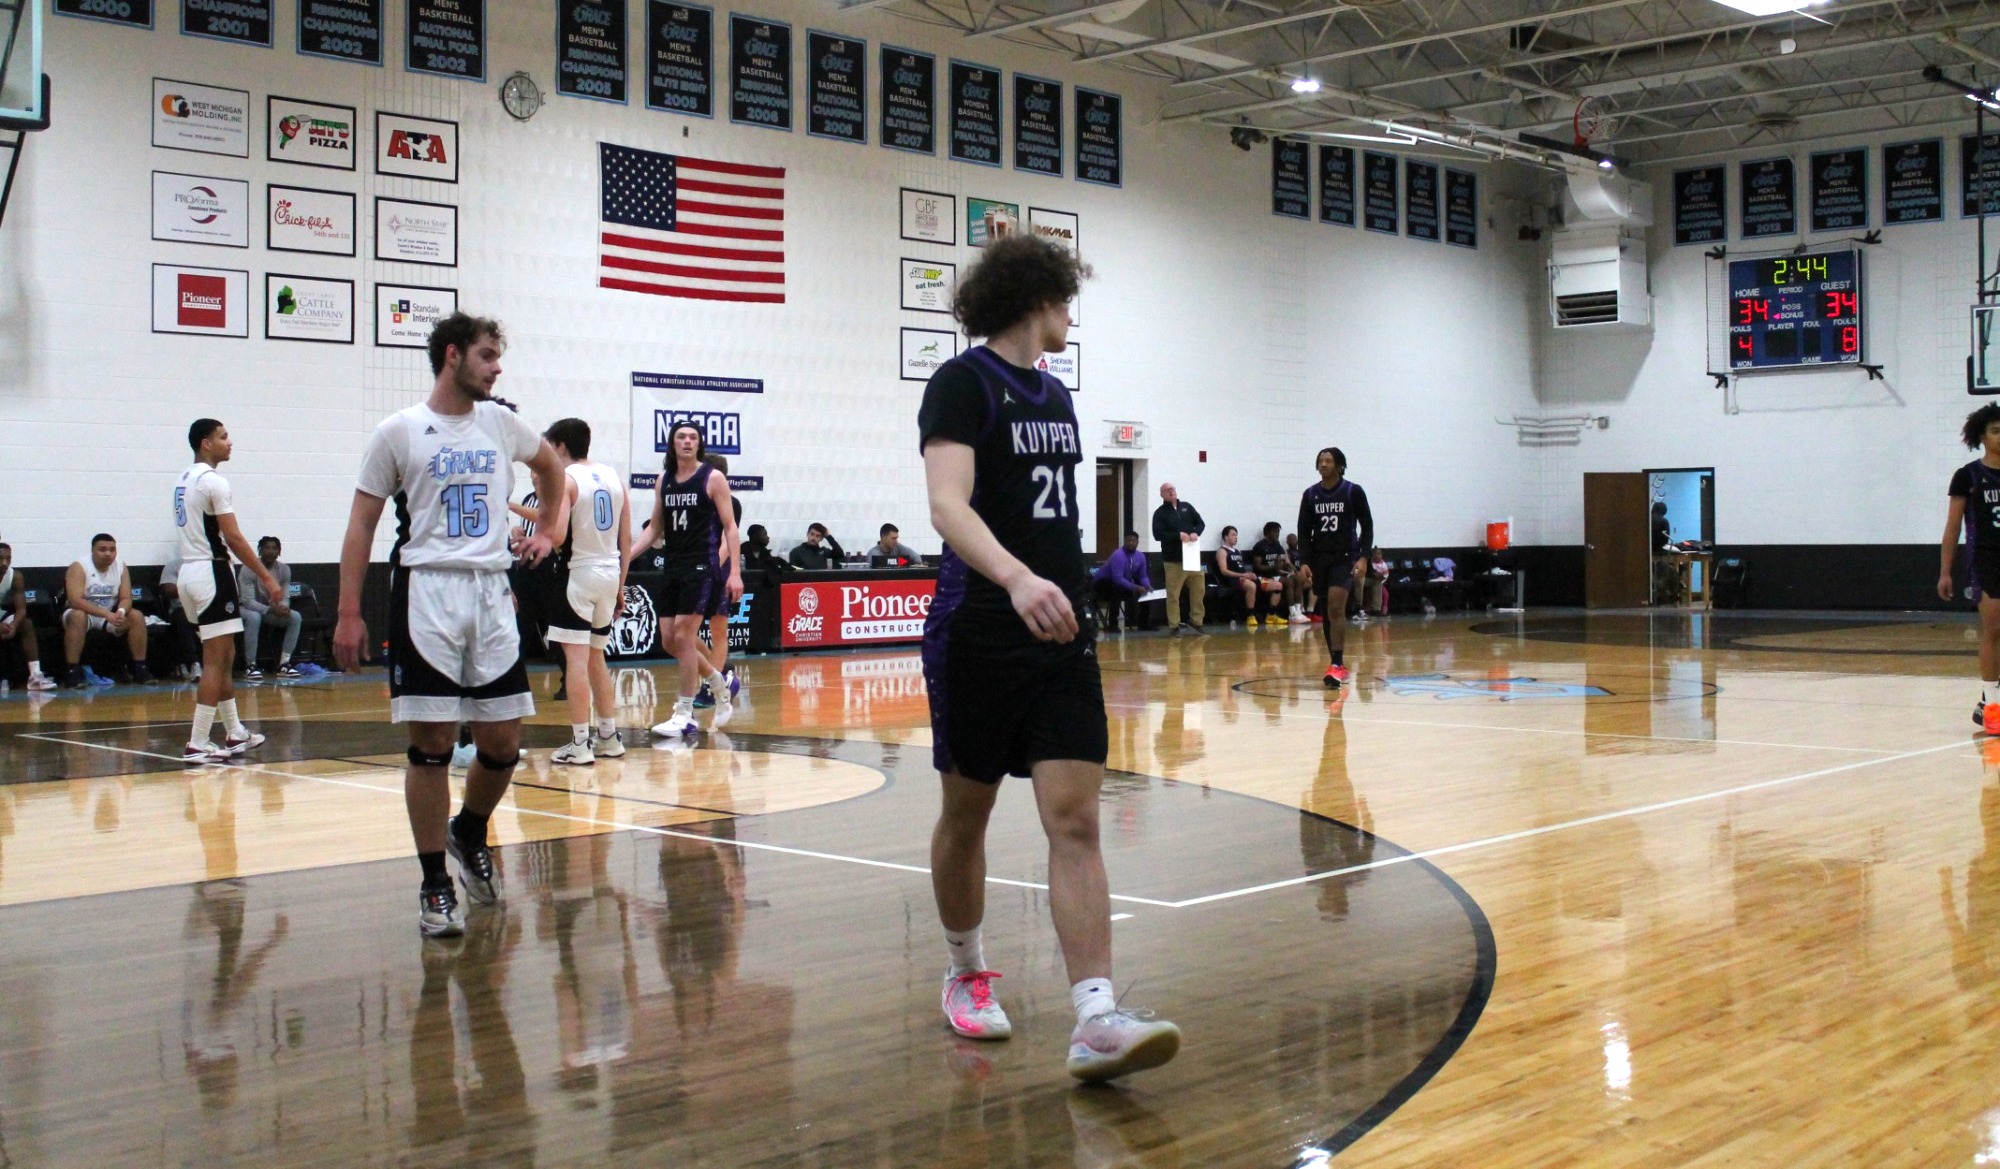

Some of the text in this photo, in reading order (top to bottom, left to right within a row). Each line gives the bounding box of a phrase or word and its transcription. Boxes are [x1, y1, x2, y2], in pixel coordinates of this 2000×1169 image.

[79, 0, 131, 17] 2000
[187, 0, 268, 20] CHAMPIONS
[433, 0, 459, 9] MEN'S
[419, 7, 474, 24] BASKETBALL
[573, 4, 612, 25] GRACE
[208, 16, 250, 36] 2001
[303, 17, 377, 40] CHAMPIONS
[418, 21, 475, 41] NATIONAL
[581, 25, 605, 37] MEN'S
[661, 20, 698, 42] GRACE
[321, 36, 363, 55] 2002
[413, 35, 479, 55] FINAL FOUR
[568, 34, 618, 50] BASKETBALL
[669, 42, 691, 52] MEN'S
[744, 38, 779, 58] GRACE
[427, 53, 467, 72] 2002
[657, 51, 703, 66] BASKETBALL
[752, 58, 773, 68] MEN'S
[561, 61, 624, 81] CHAMPIONS
[657, 63, 704, 81] NATIONAL
[741, 66, 783, 81] BASKETBALL
[828, 72, 848, 83] MEN'S
[817, 80, 857, 95] BASKETBALL
[899, 86, 918, 97] MEN'S
[192, 101, 243, 114] WEST MICHIGAN
[664, 92, 698, 109] 2005
[889, 94, 928, 109] BASKETBALL
[963, 100, 989, 111] WOMEN'S
[957, 108, 994, 121] BASKETBALL
[1030, 112, 1047, 121] MEN'S
[309, 118, 349, 139] JET'S
[1021, 120, 1056, 133] BASKETBALL
[1090, 124, 1107, 134] MEN'S
[310, 136, 348, 150] PIZZA
[1082, 132, 1115, 145] BASKETBALL
[387, 129, 447, 164] ATA
[1891, 178, 1933, 188] BASKETBALL
[275, 206, 332, 230] Chick-fil-A
[405, 216, 448, 228] NORTH STAR
[314, 230, 326, 238] 54th
[910, 267, 943, 280] SUBWAY
[1774, 257, 1826, 284] 2:44
[1735, 280, 1851, 298] HOME PERIOD GUEST
[182, 291, 222, 304] Pioneer
[299, 297, 336, 309] CATTLE
[297, 306, 345, 320] COMPANY
[412, 303, 440, 313] Standale
[1739, 292, 1857, 325] 34 34
[1782, 303, 1802, 311] POSS
[413, 313, 440, 323] Interior
[1781, 311, 1804, 319] BONUS
[1768, 322, 1794, 330] PLAYER
[1739, 327, 1857, 358] 4 8
[908, 359, 929, 367] Gazelle
[1050, 356, 1073, 366] SHERWIN
[1049, 364, 1073, 374] WILLIAMS
[634, 375, 758, 389] NATIONAL CHRISTIAN COLLEGE ATHLETIC ASSOCIATION
[1011, 421, 1077, 455] KUYPER
[1121, 426, 1133, 439] EXIT
[428, 446, 496, 481] GRACE
[633, 477, 758, 490] #KingCh PlayForHim
[1031, 465, 1069, 519] 21
[175, 486, 187, 527] 5
[665, 493, 697, 507] KUYPER
[441, 484, 489, 537] 15
[594, 489, 614, 531] 0
[1315, 502, 1344, 514] KUYPER
[671, 510, 688, 531] 14
[1320, 515, 1339, 532] 23
[841, 586, 932, 619] Pionee
[787, 614, 823, 634] GRACE
[846, 624, 920, 635] CONSTRUCT
